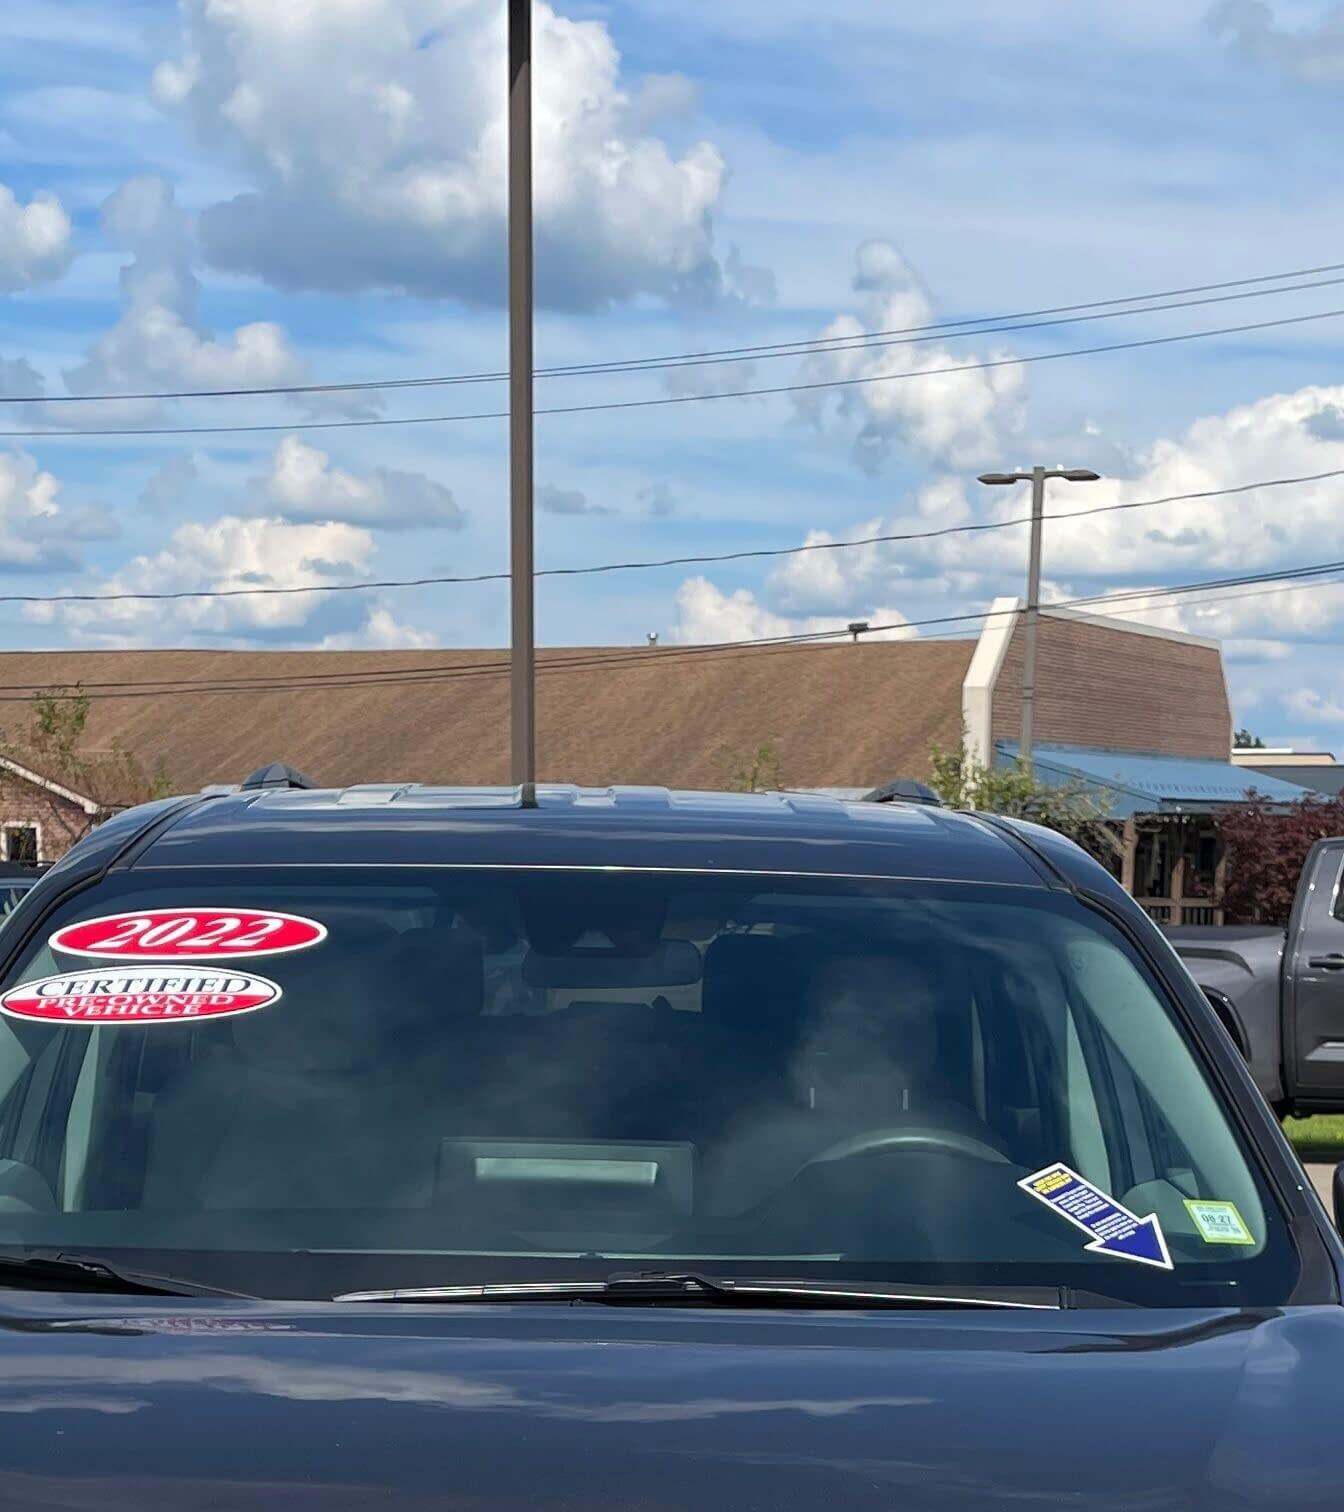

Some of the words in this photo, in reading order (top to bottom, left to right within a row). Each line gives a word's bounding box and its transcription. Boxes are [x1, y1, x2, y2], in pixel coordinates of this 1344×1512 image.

[87, 917, 284, 949] 2022
[36, 977, 252, 997] CERTIFIED
[37, 993, 235, 1010] PRE-OWNED
[62, 1001, 202, 1017] VEHICLE
